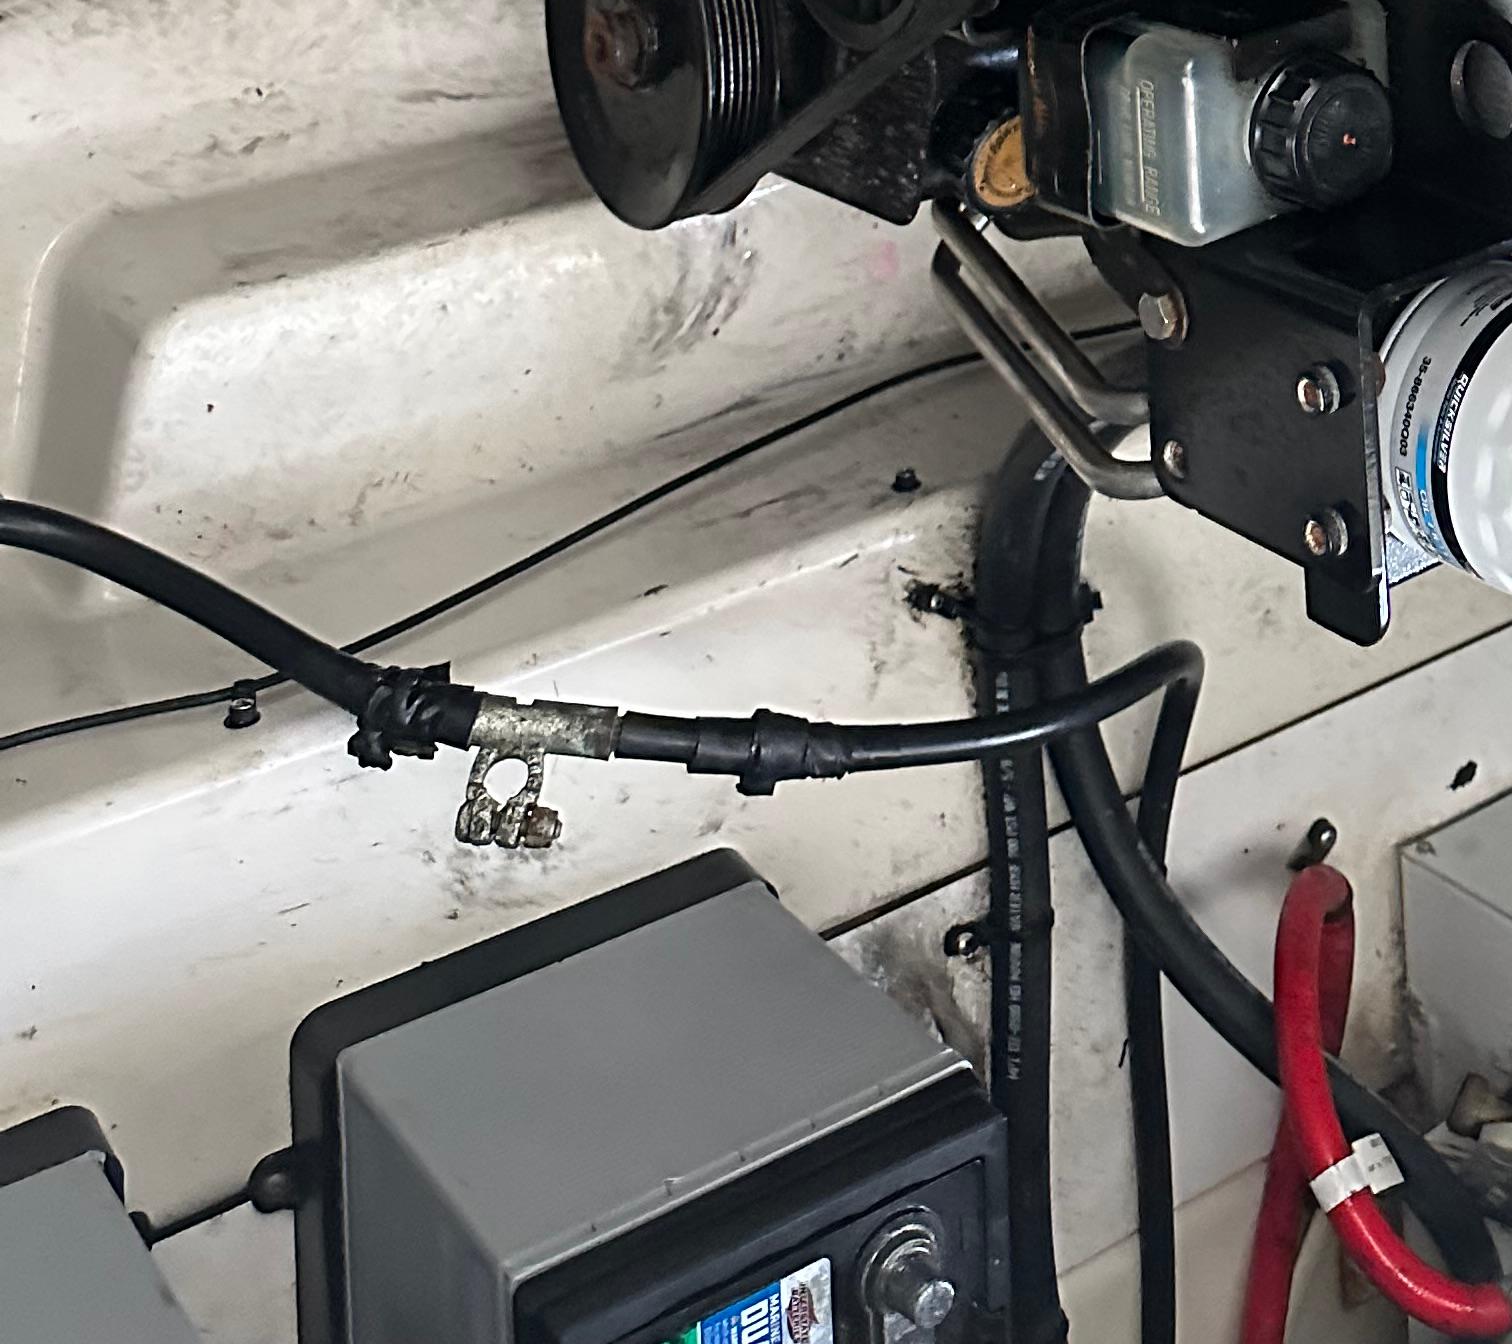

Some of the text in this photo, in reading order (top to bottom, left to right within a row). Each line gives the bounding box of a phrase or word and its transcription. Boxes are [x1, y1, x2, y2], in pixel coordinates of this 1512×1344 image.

[1139, 79, 1160, 216] OPERATING RANGE
[1437, 372, 1469, 473] QUICKSILVER
[1419, 489, 1430, 513] OIL
